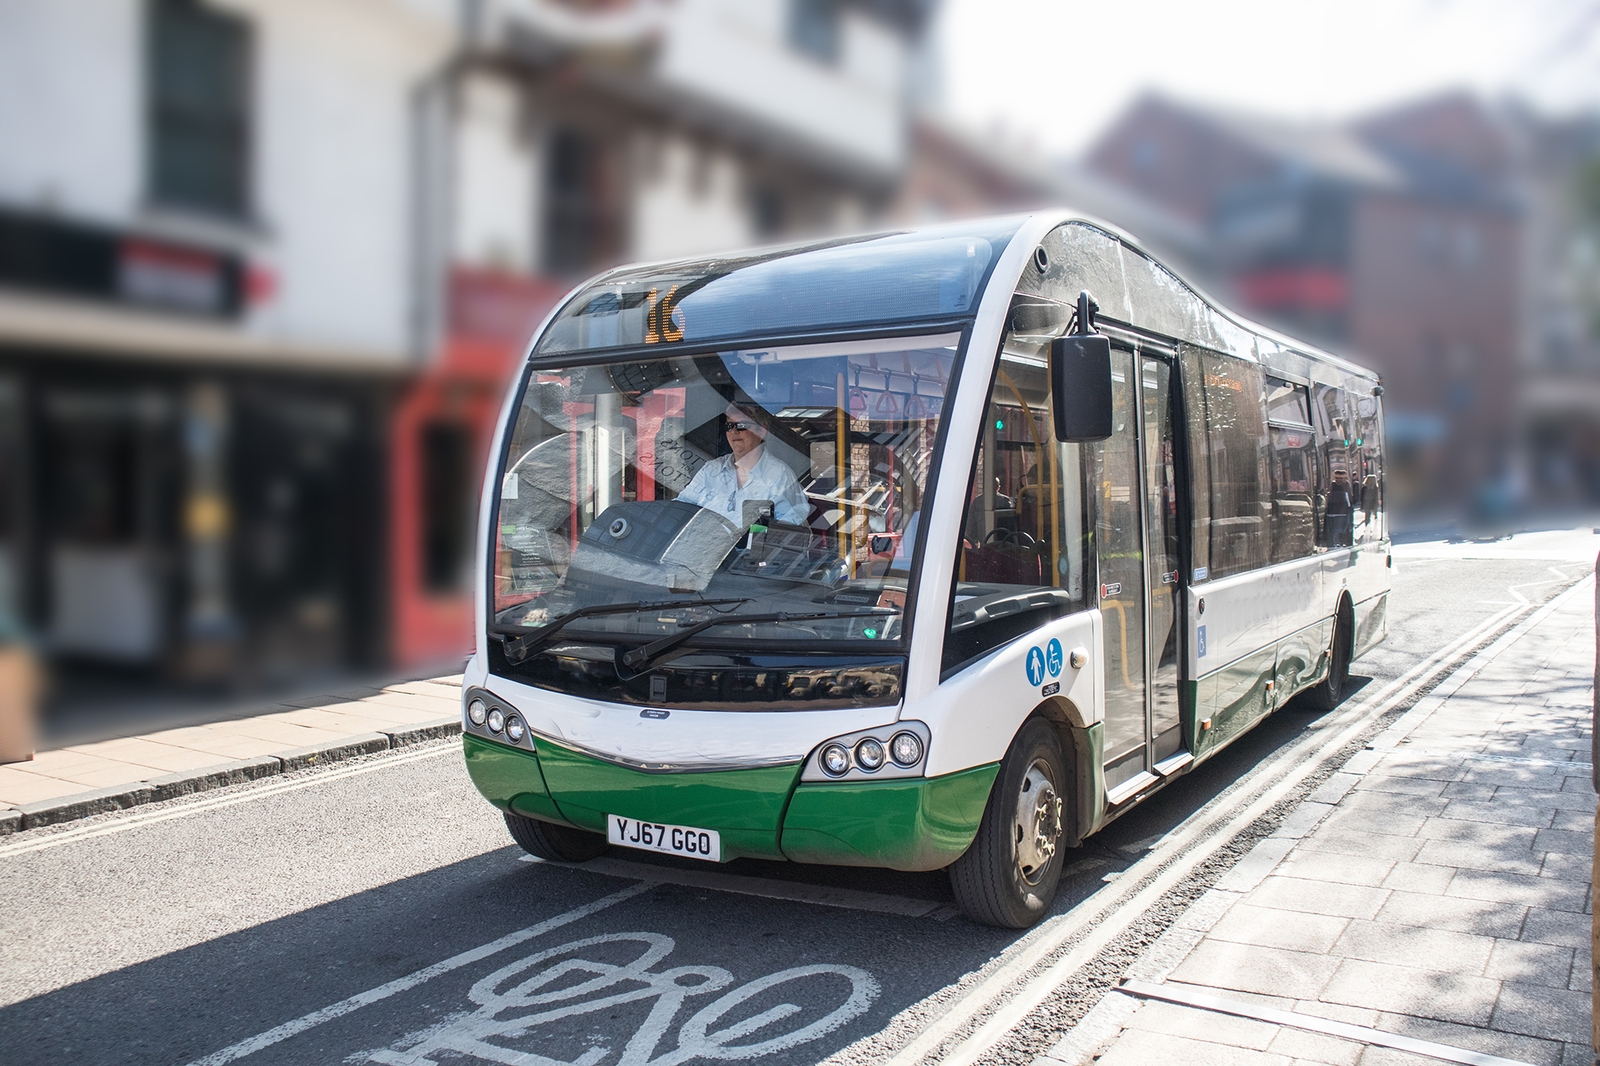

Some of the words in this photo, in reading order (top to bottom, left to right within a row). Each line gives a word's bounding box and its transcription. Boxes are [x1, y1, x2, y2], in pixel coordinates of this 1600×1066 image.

[645, 284, 685, 343] 16
[617, 818, 665, 847] YJ67
[671, 828, 710, 855] GGO
